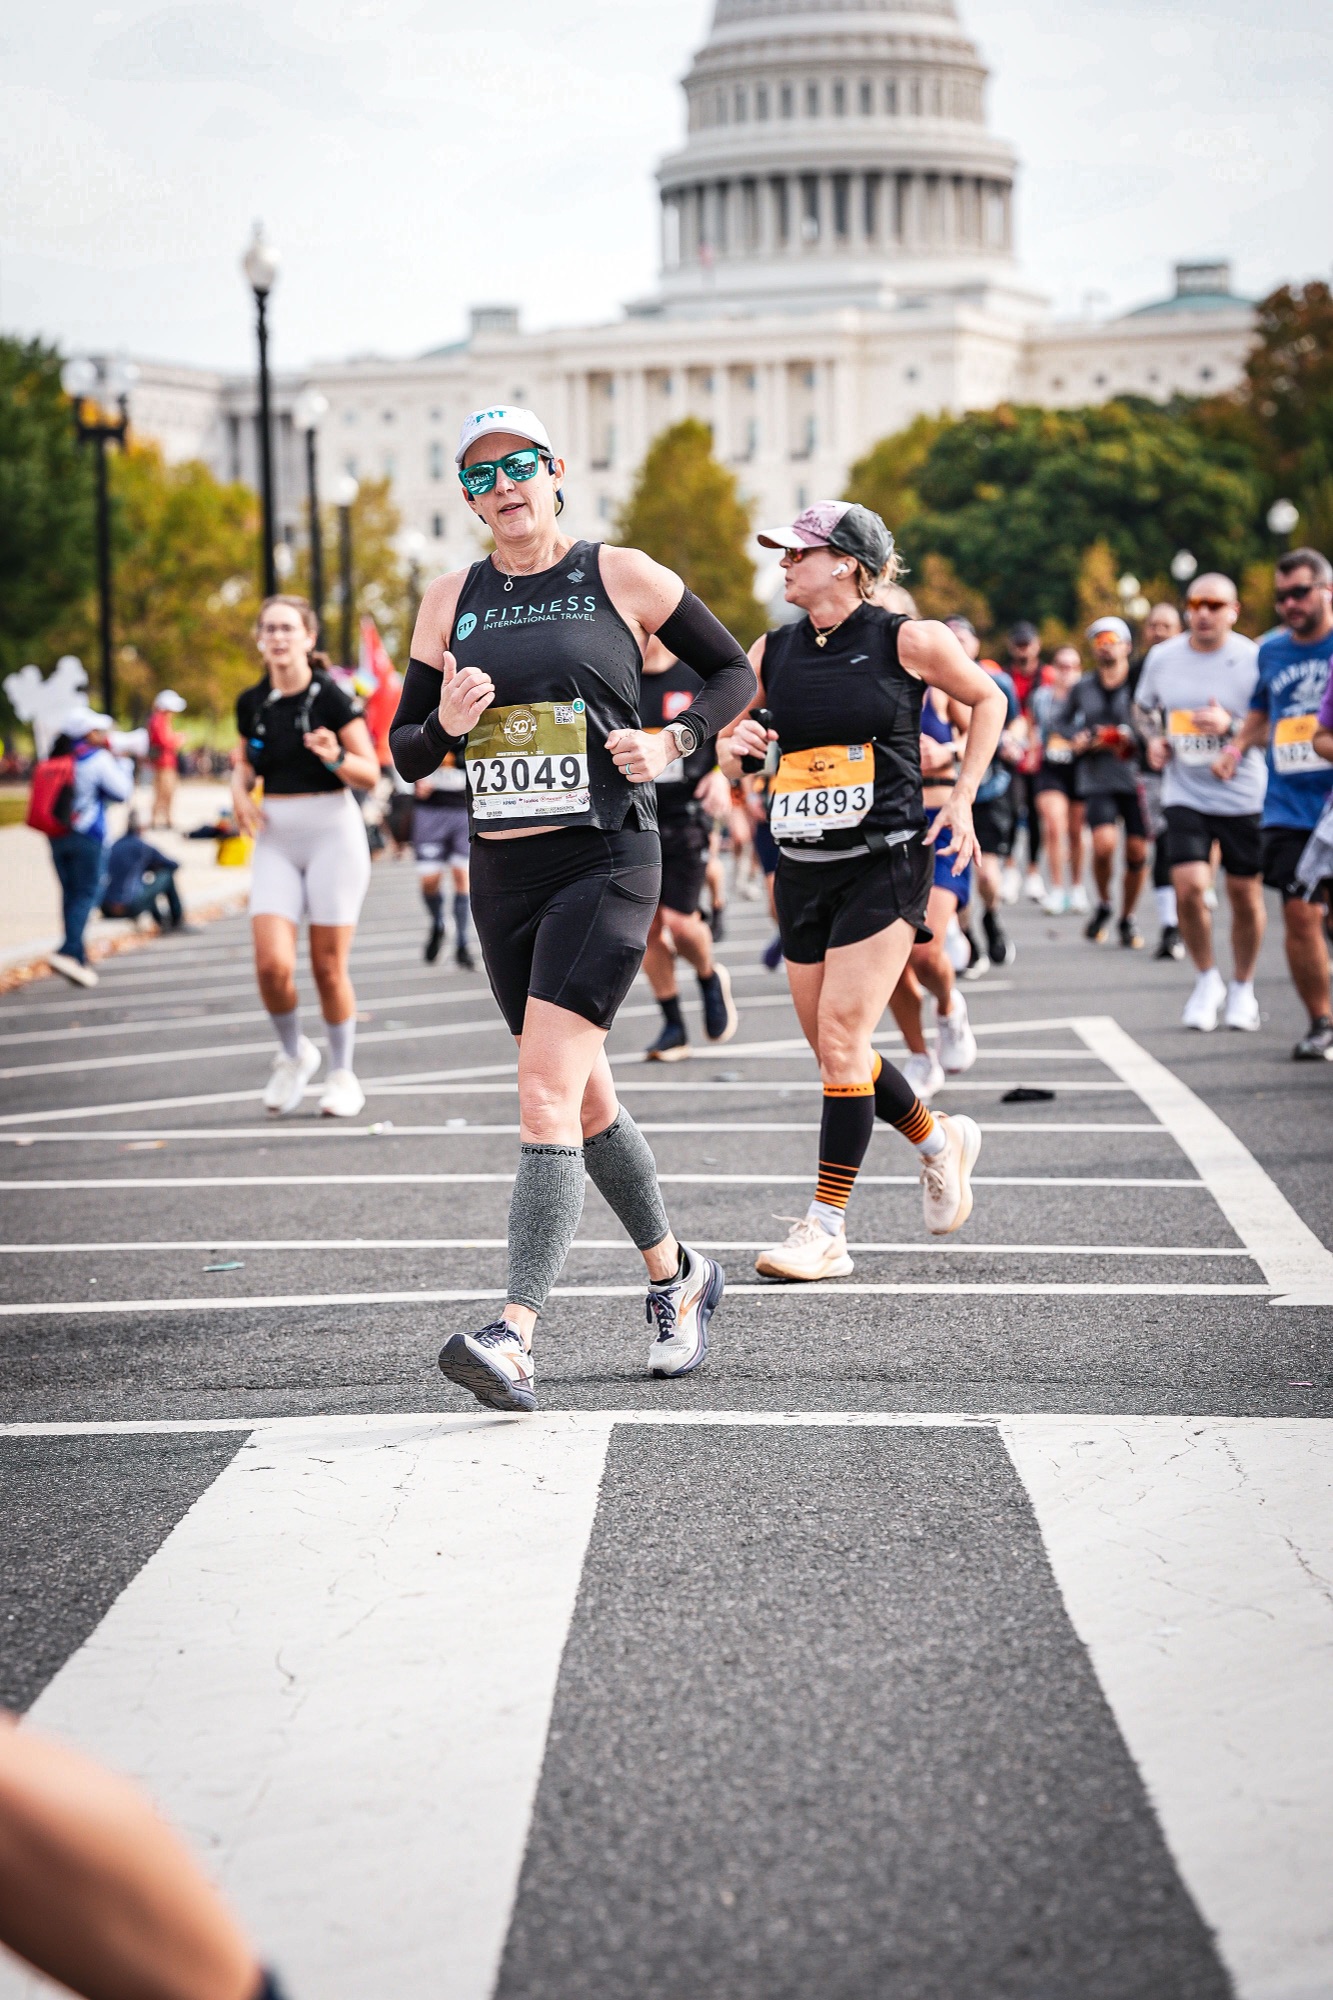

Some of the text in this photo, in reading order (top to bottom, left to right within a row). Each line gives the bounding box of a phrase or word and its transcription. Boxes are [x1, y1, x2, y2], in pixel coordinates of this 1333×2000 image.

[483, 613, 596, 631] INTERNATIONAL TRAVEL
[484, 596, 596, 622] FITNESS
[458, 619, 475, 635] FIT
[472, 756, 581, 793] 23049
[780, 787, 866, 817] 14893
